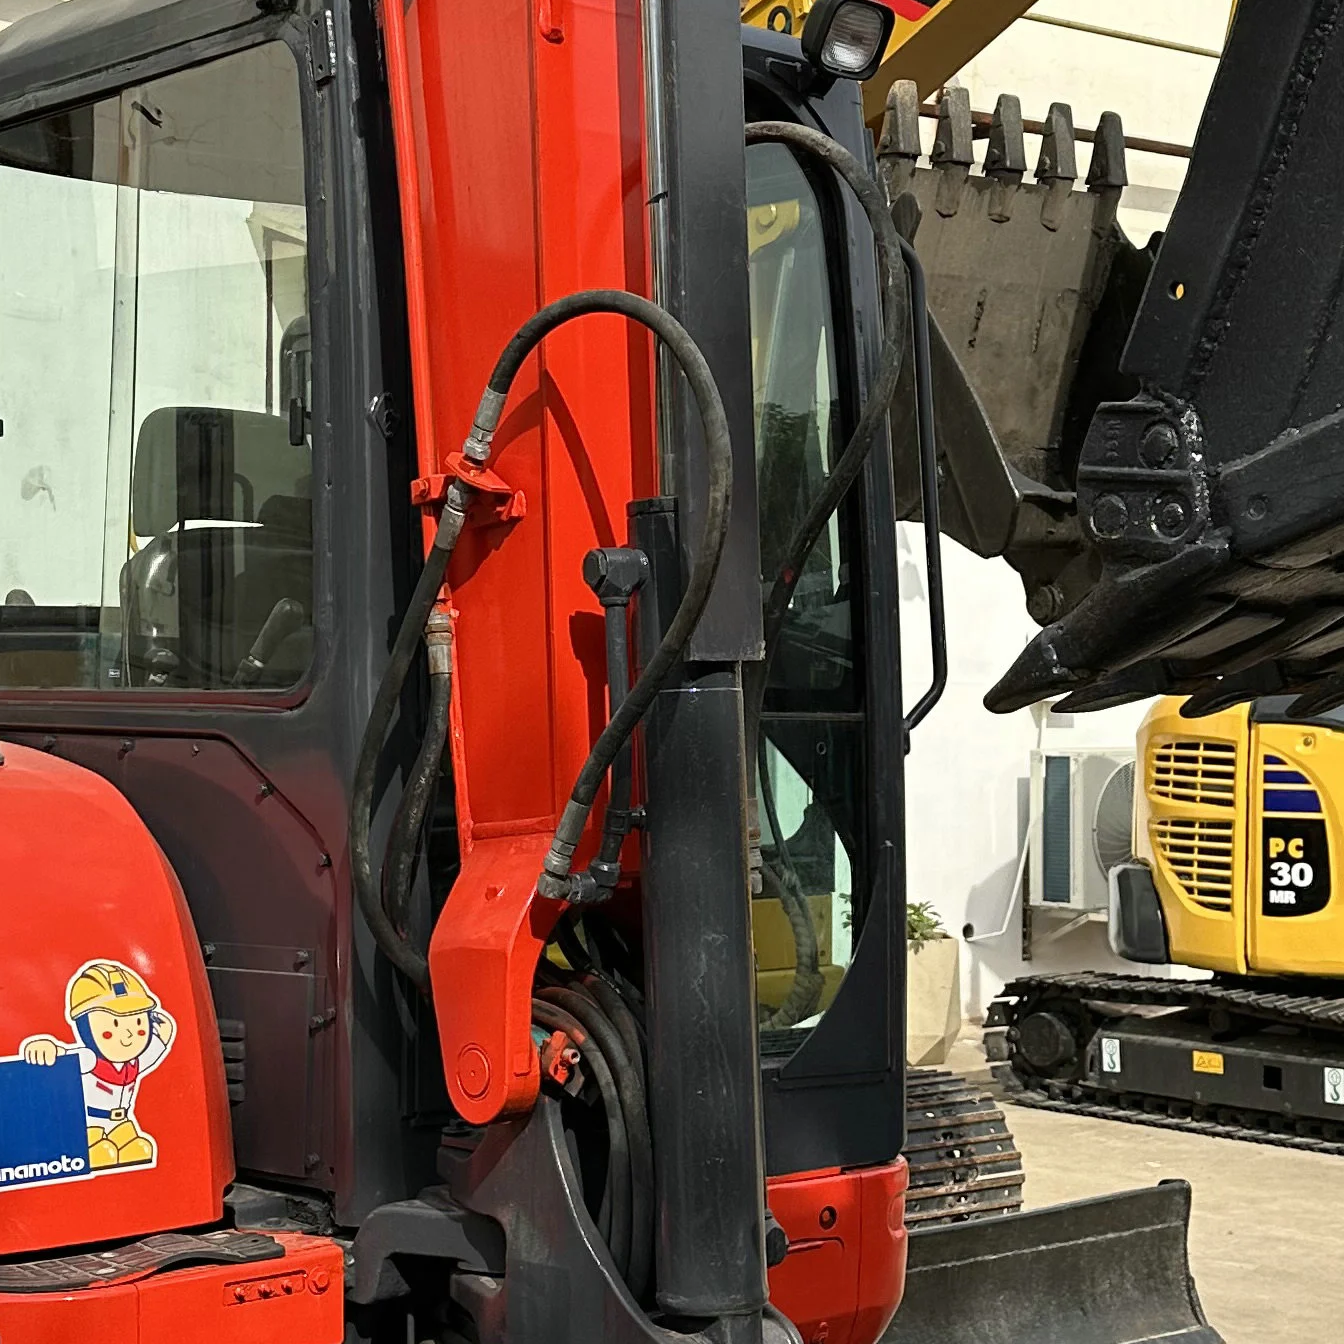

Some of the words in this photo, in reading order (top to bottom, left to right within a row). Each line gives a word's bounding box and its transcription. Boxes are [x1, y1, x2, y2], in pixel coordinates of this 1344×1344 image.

[1269, 838, 1304, 858] PC
[1270, 862, 1314, 887] 30
[1269, 890, 1296, 904] MR
